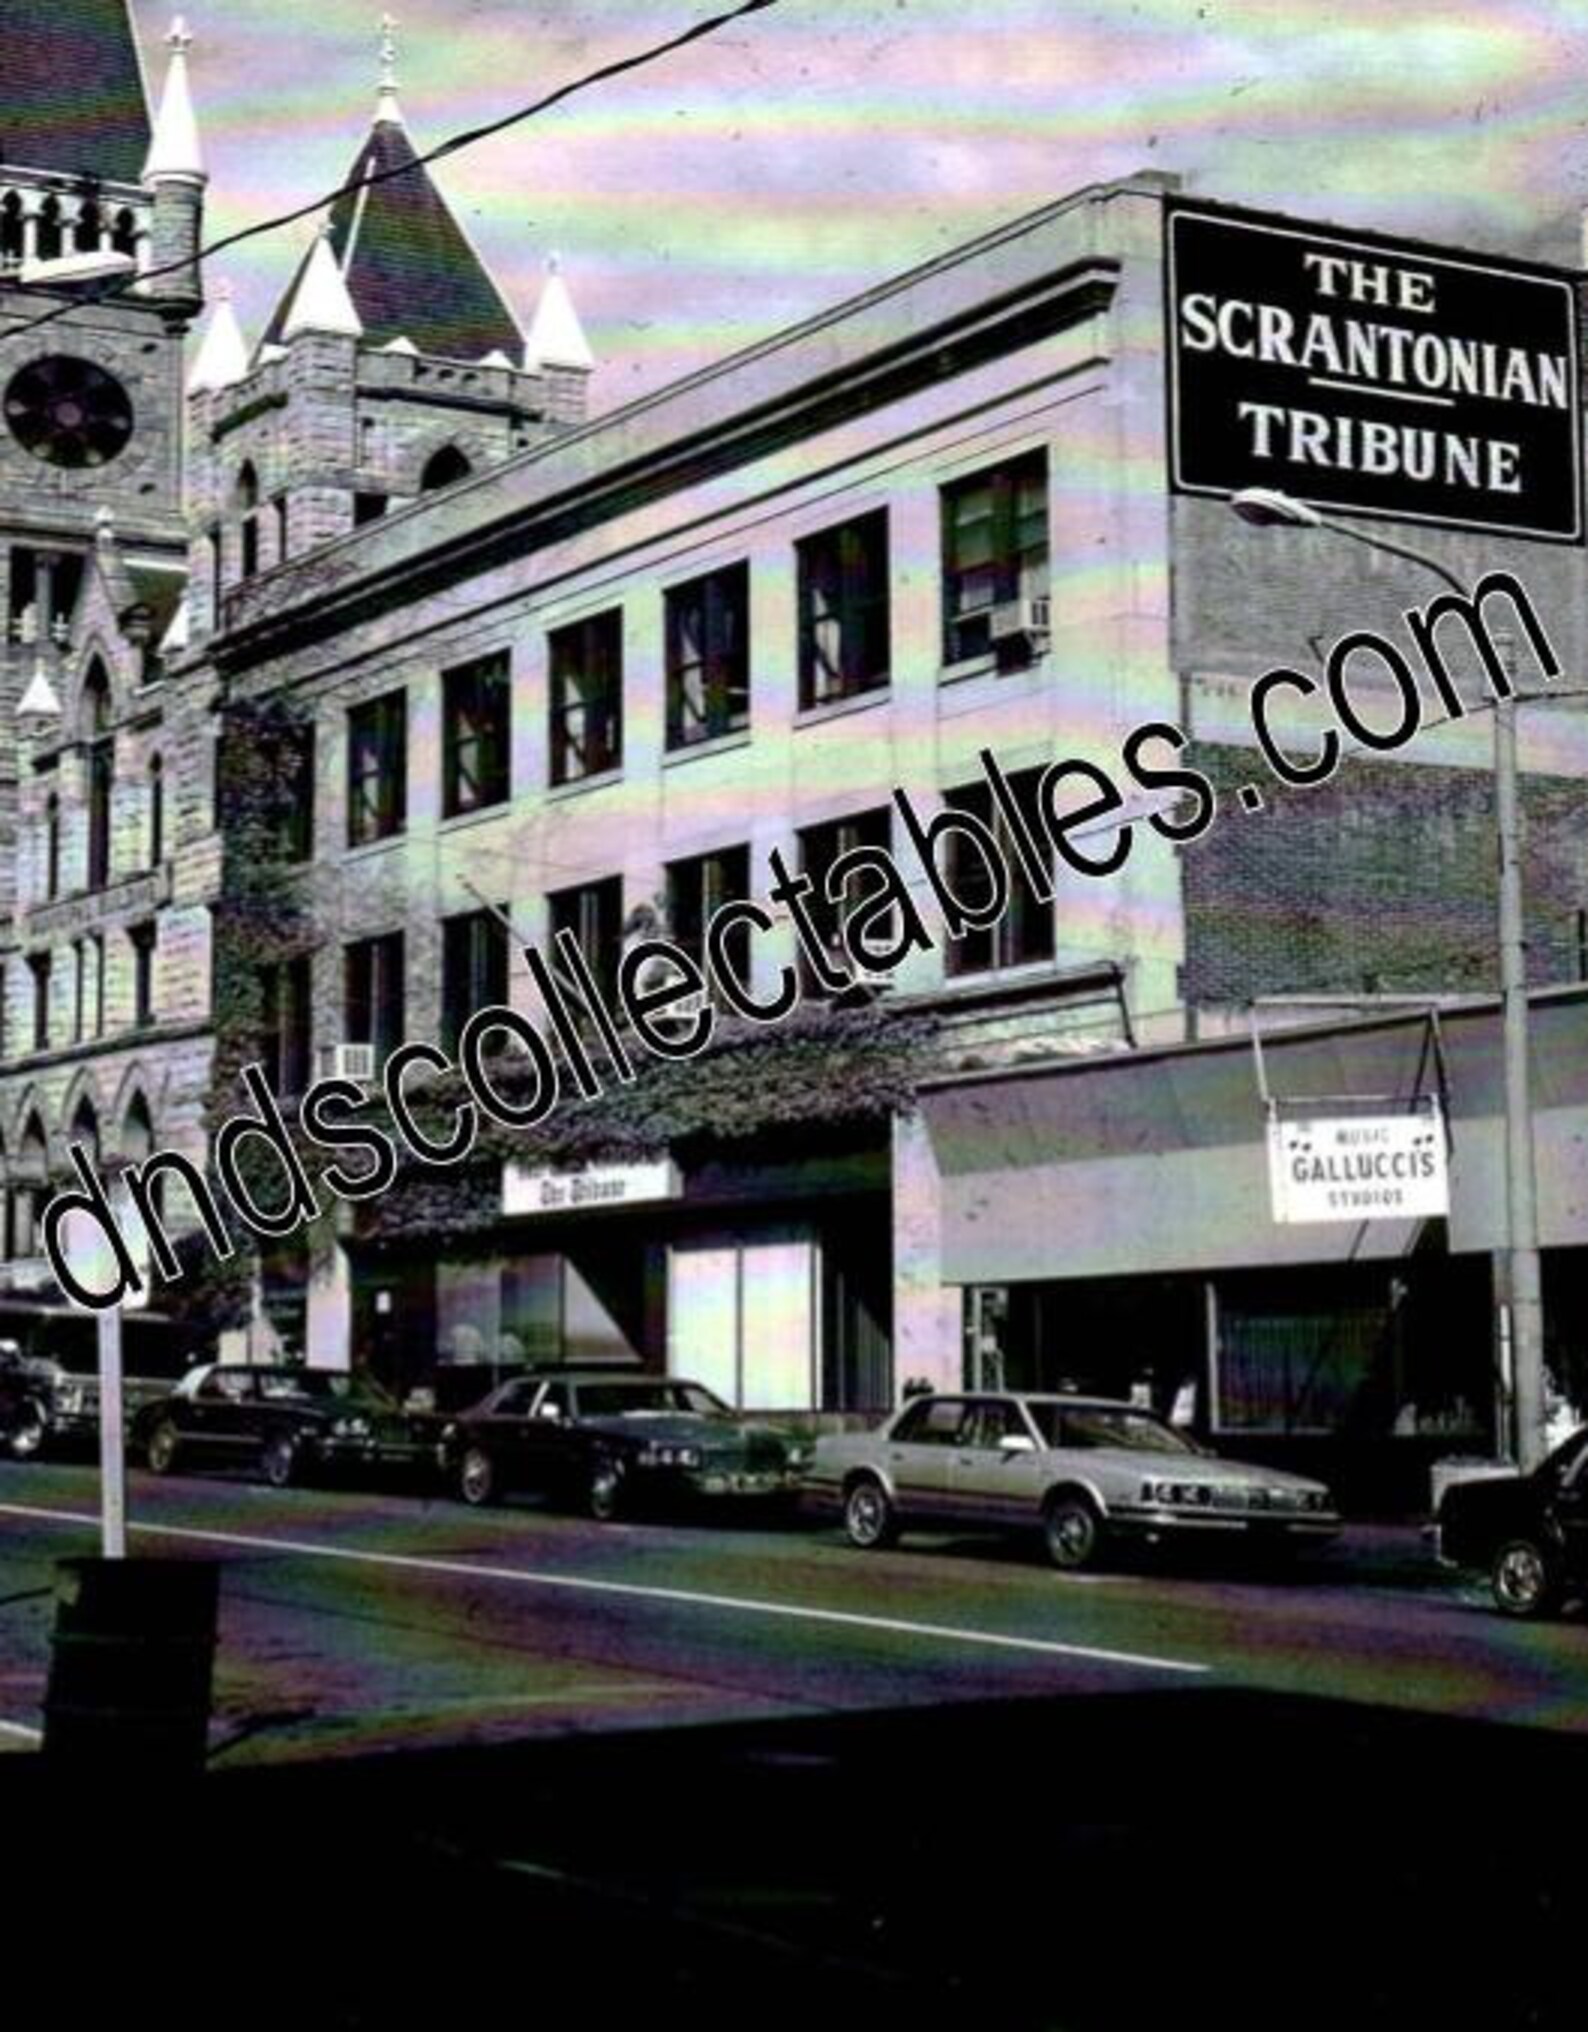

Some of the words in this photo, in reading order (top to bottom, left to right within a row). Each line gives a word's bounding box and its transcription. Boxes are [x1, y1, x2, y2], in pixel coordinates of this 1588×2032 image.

[1304, 253, 1437, 314] THE
[1181, 293, 1568, 410] SCRANTONIAN
[1238, 401, 1522, 493] TRIBUNE
